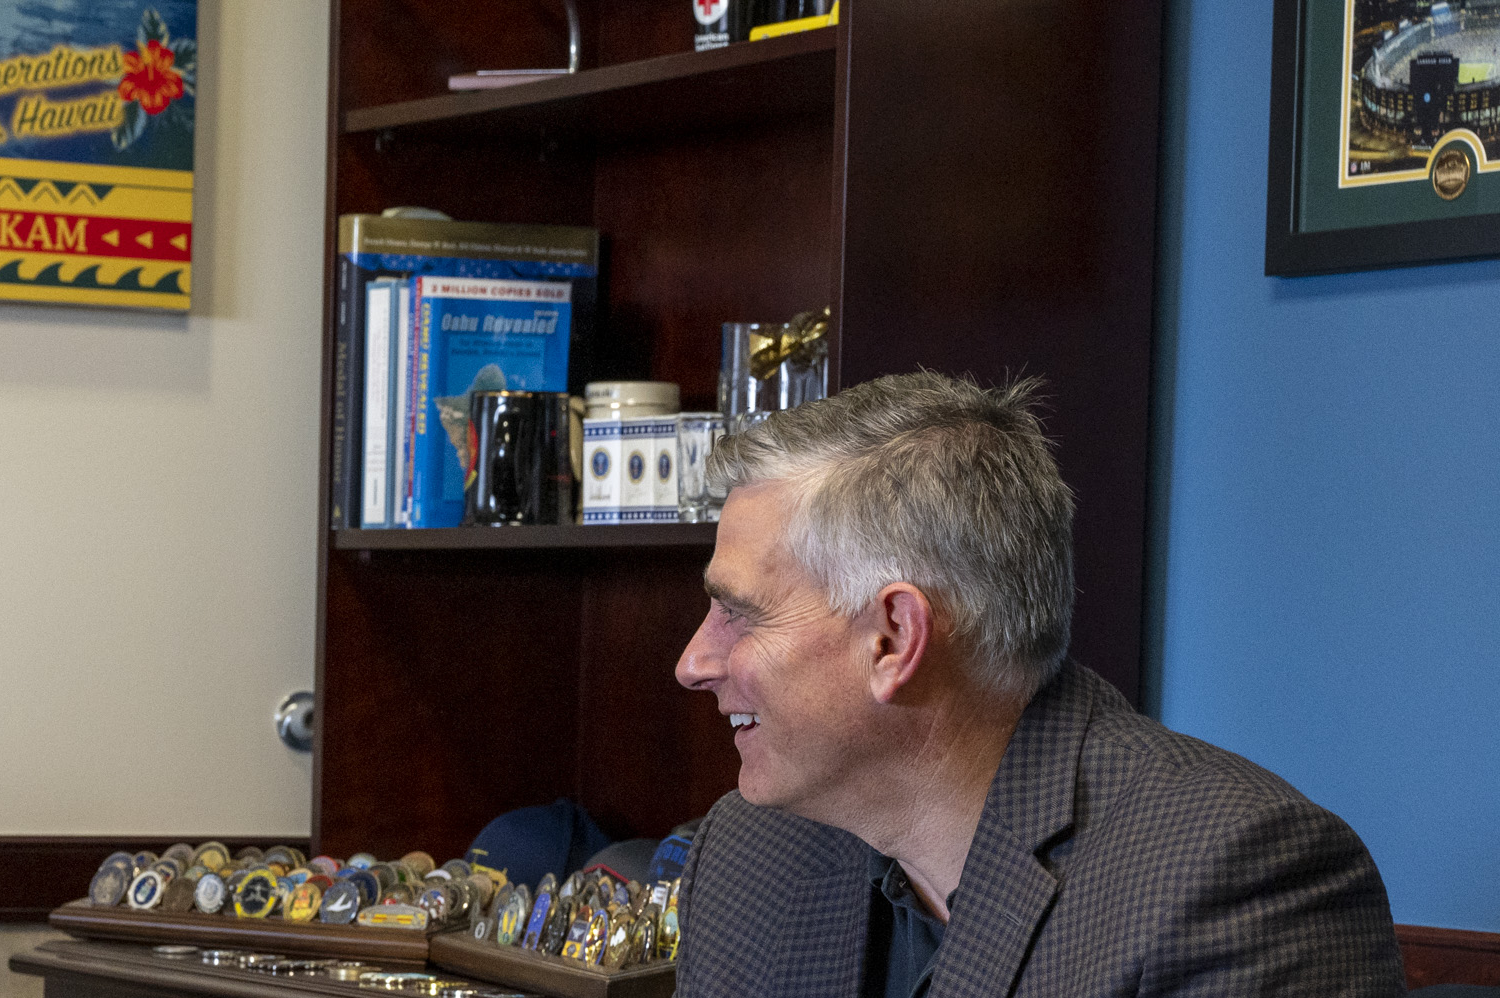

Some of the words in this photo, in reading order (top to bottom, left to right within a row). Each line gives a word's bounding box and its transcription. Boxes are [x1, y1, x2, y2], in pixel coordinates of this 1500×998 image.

[16, 98, 119, 134] Hawaii
[441, 285, 487, 295] MILLION
[490, 286, 531, 297] COPIES
[535, 288, 565, 299] SOLD
[441, 312, 479, 332] Oahu
[482, 311, 559, 334] Revealed
